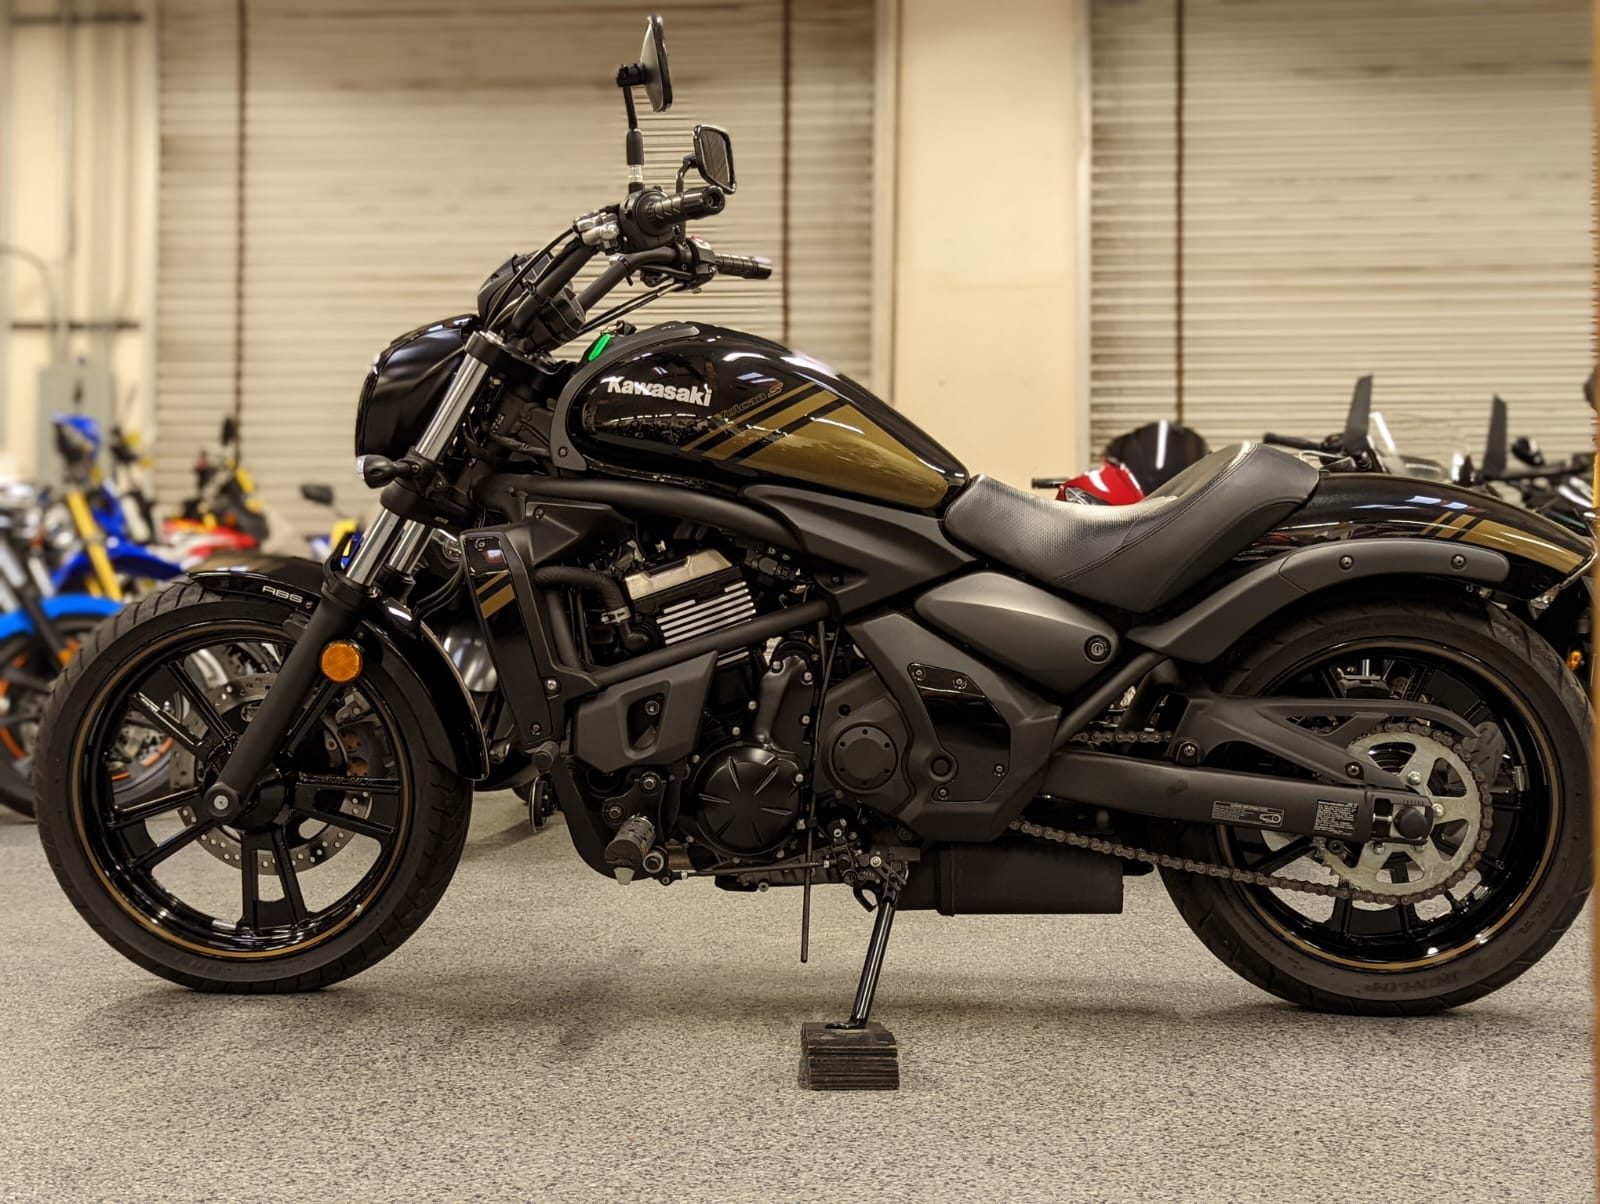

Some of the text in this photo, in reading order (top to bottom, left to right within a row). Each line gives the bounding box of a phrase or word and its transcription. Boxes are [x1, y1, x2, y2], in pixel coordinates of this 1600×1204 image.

[606, 376, 712, 407] Kawasaki
[767, 380, 784, 398] S
[262, 585, 304, 603] ABS
